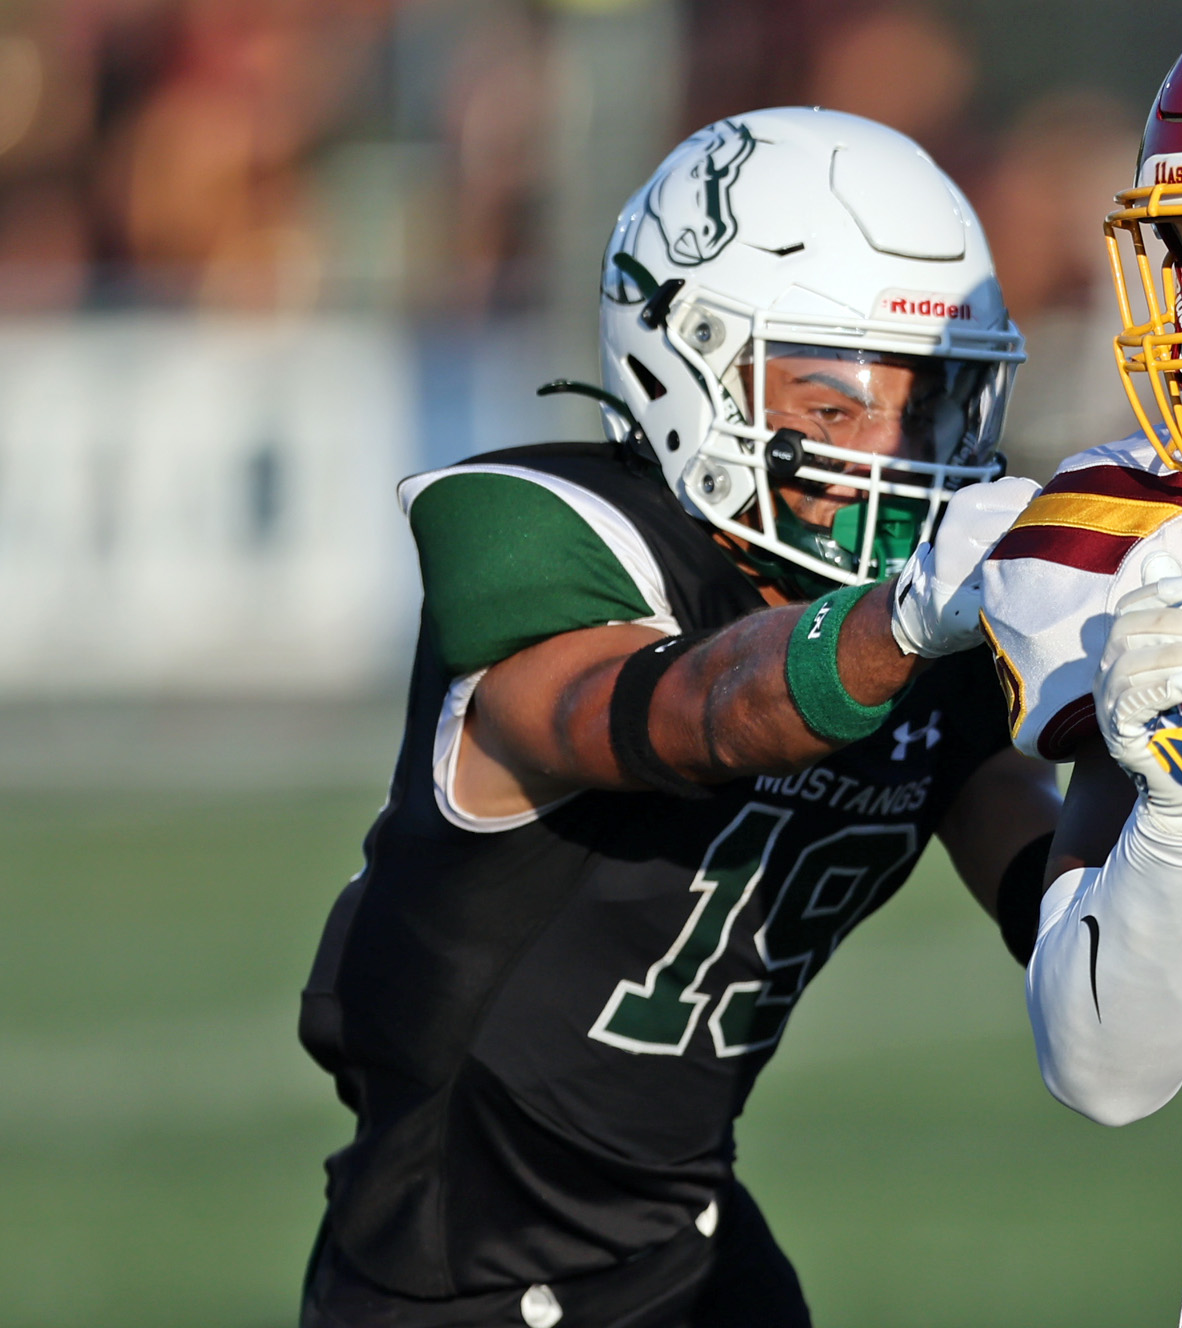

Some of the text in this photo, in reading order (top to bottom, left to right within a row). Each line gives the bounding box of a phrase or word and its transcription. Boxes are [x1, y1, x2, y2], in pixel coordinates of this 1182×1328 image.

[889, 298, 971, 320] Riddell
[754, 766, 932, 816] MUSTANGS
[587, 801, 918, 1058] 19
